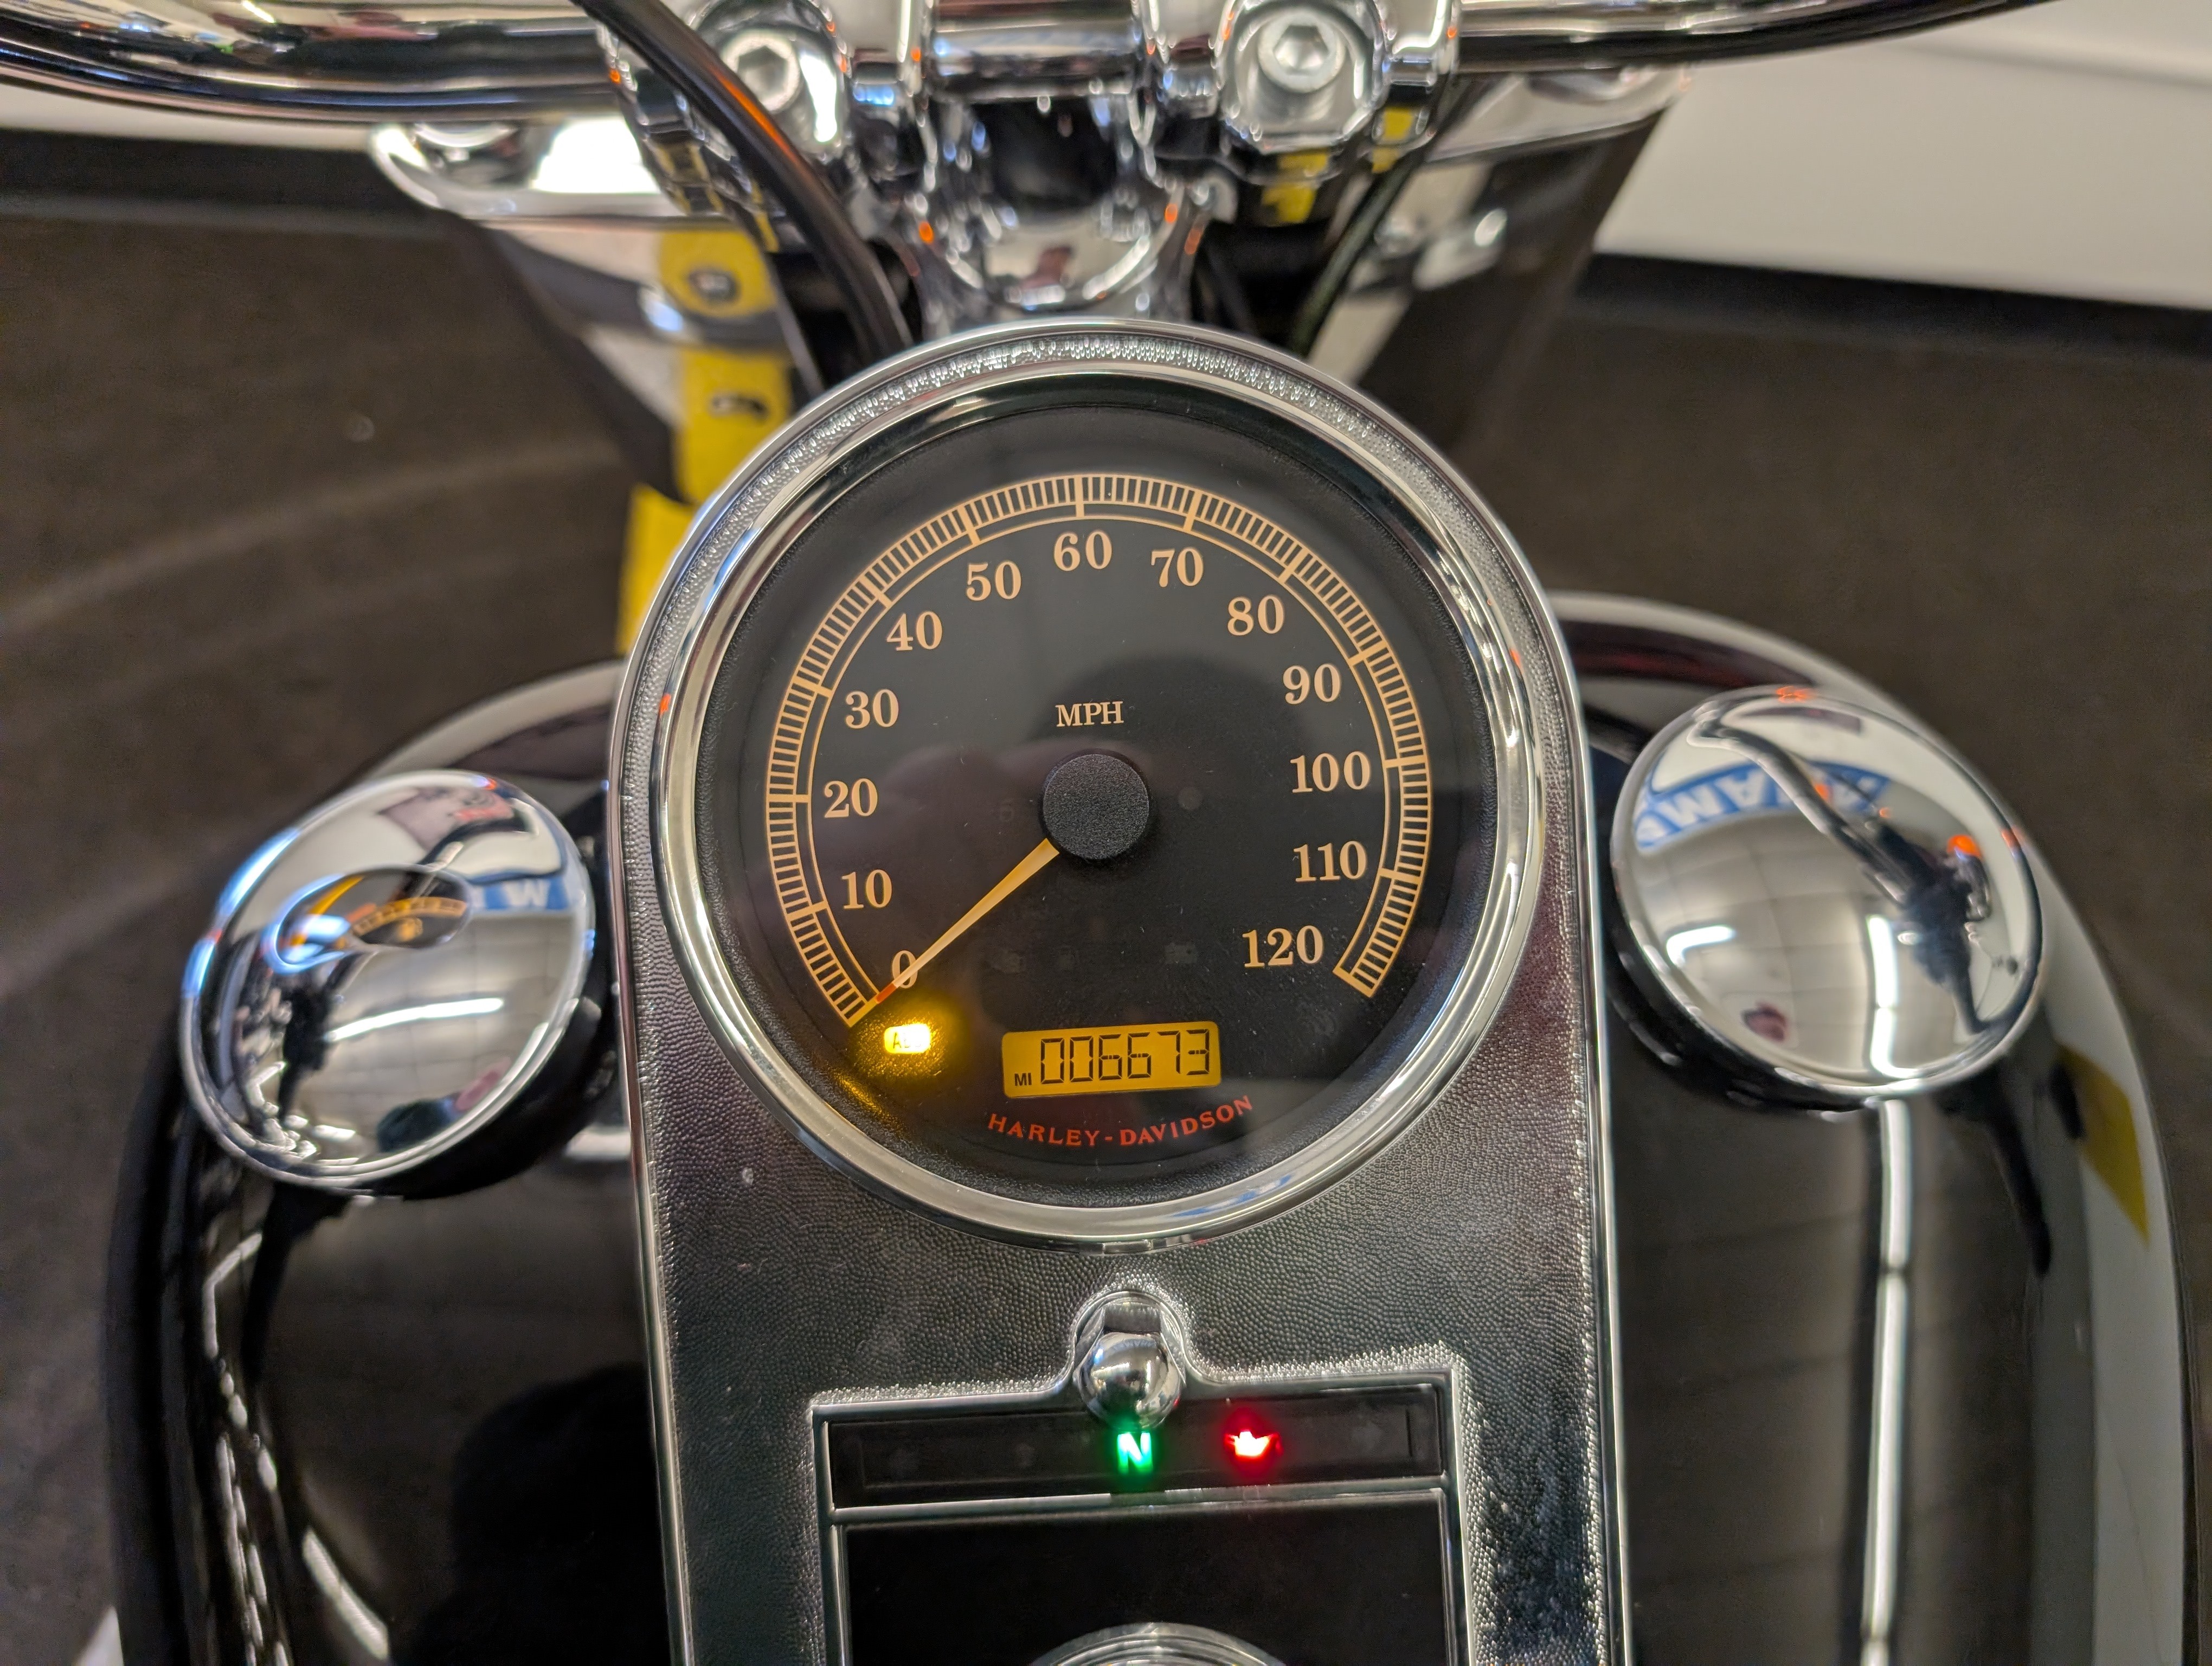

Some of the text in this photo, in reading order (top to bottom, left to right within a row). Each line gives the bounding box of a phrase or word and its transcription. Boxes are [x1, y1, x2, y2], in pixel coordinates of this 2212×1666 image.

[1054, 530, 1112, 571] 60
[1151, 547, 1203, 587] 70
[966, 561, 1021, 601] 50
[886, 611, 942, 651] 40
[1227, 595, 1284, 636] 80
[1283, 664, 1341, 704] 90
[846, 689, 898, 728] 30
[1056, 701, 1124, 727] MPH
[1290, 751, 1371, 792] 100
[824, 778, 877, 818] 20
[1294, 841, 1366, 881] 110
[842, 870, 892, 909] 10
[1243, 926, 1323, 967] 120
[892, 950, 918, 989] 0
[1014, 1029, 1210, 1086] MI 006673
[1117, 1432, 1153, 1474] N
